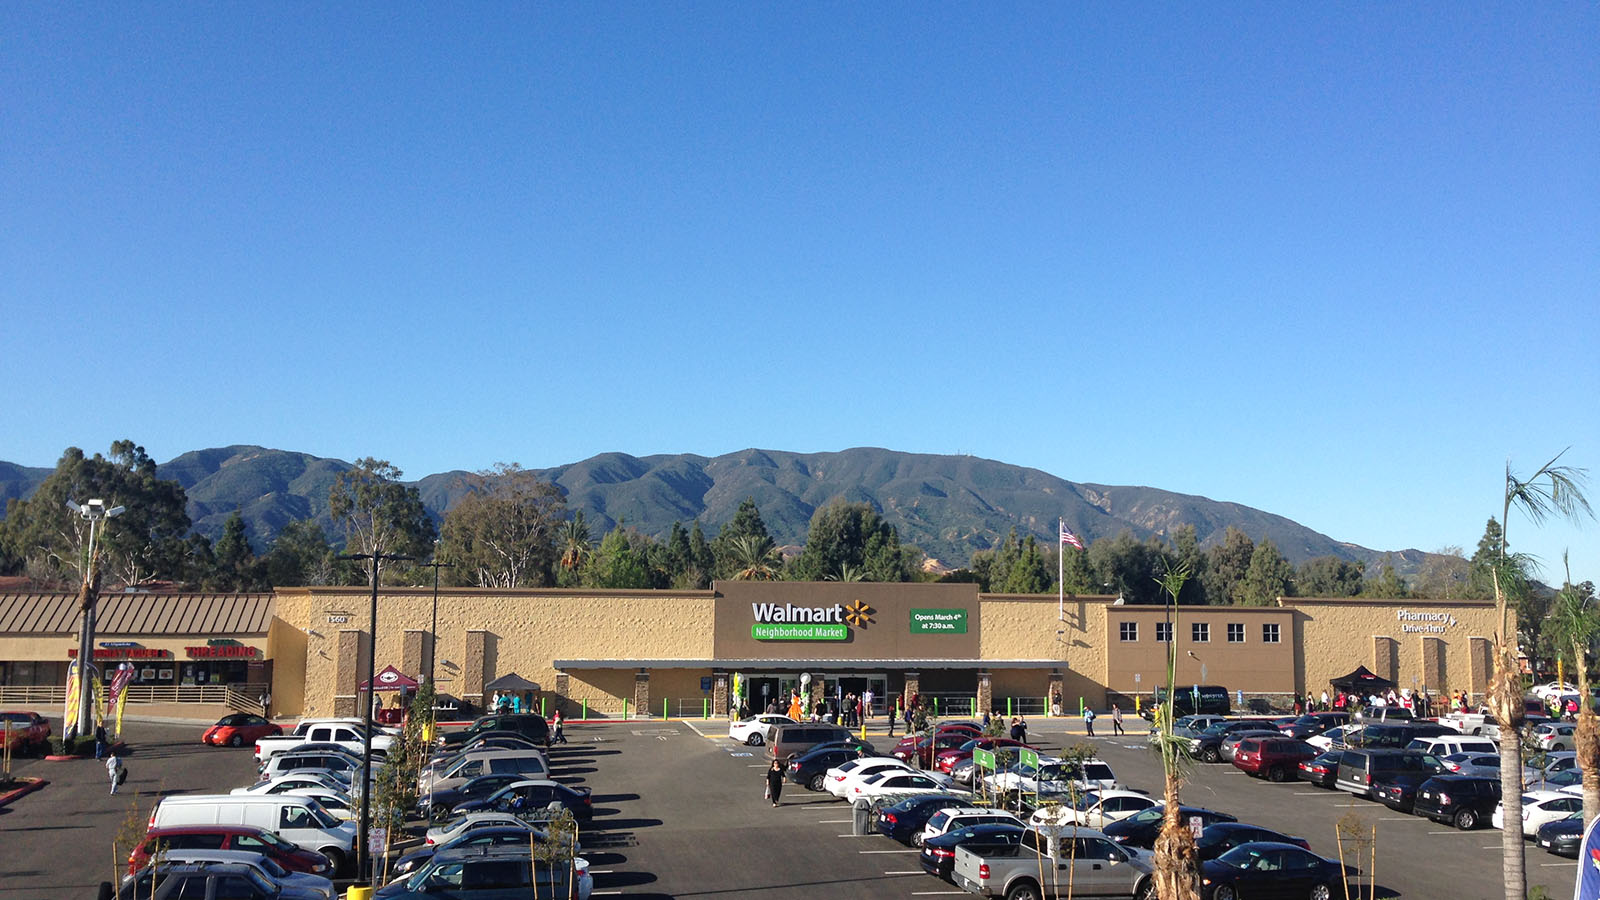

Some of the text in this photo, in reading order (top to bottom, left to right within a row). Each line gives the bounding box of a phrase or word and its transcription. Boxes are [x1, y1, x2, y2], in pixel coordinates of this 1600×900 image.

[752, 603, 842, 622] Walmart
[1397, 609, 1450, 624] Pharmacy
[756, 627, 843, 638] Neighborhood Market
[184, 646, 256, 657] THREADING
